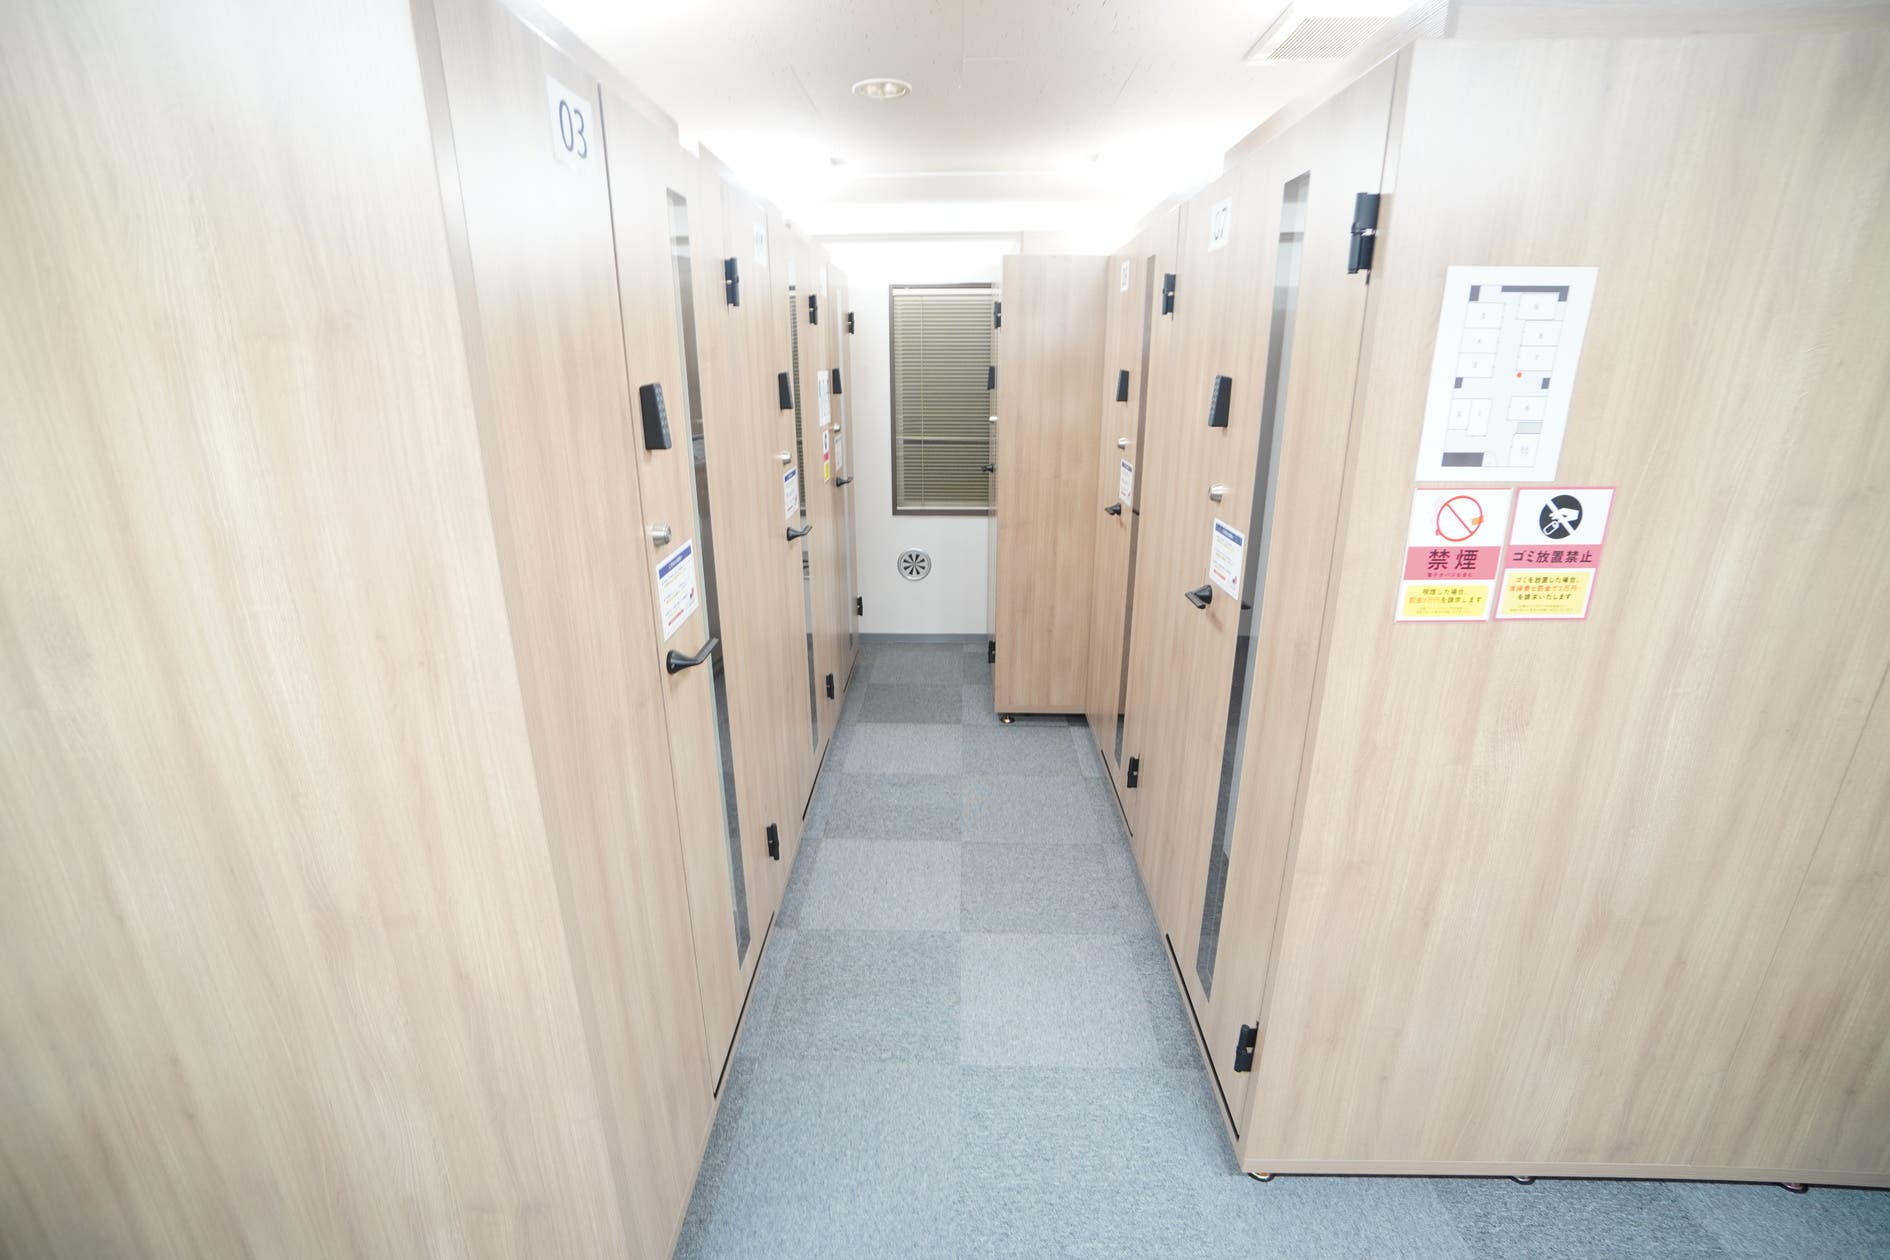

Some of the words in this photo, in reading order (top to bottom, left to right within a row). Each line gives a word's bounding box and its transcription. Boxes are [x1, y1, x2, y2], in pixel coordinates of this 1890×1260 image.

[559, 100, 588, 159] 03
[1428, 549, 1479, 570] 禁煙
[1513, 550, 1592, 563] ゴミ放置禁止
